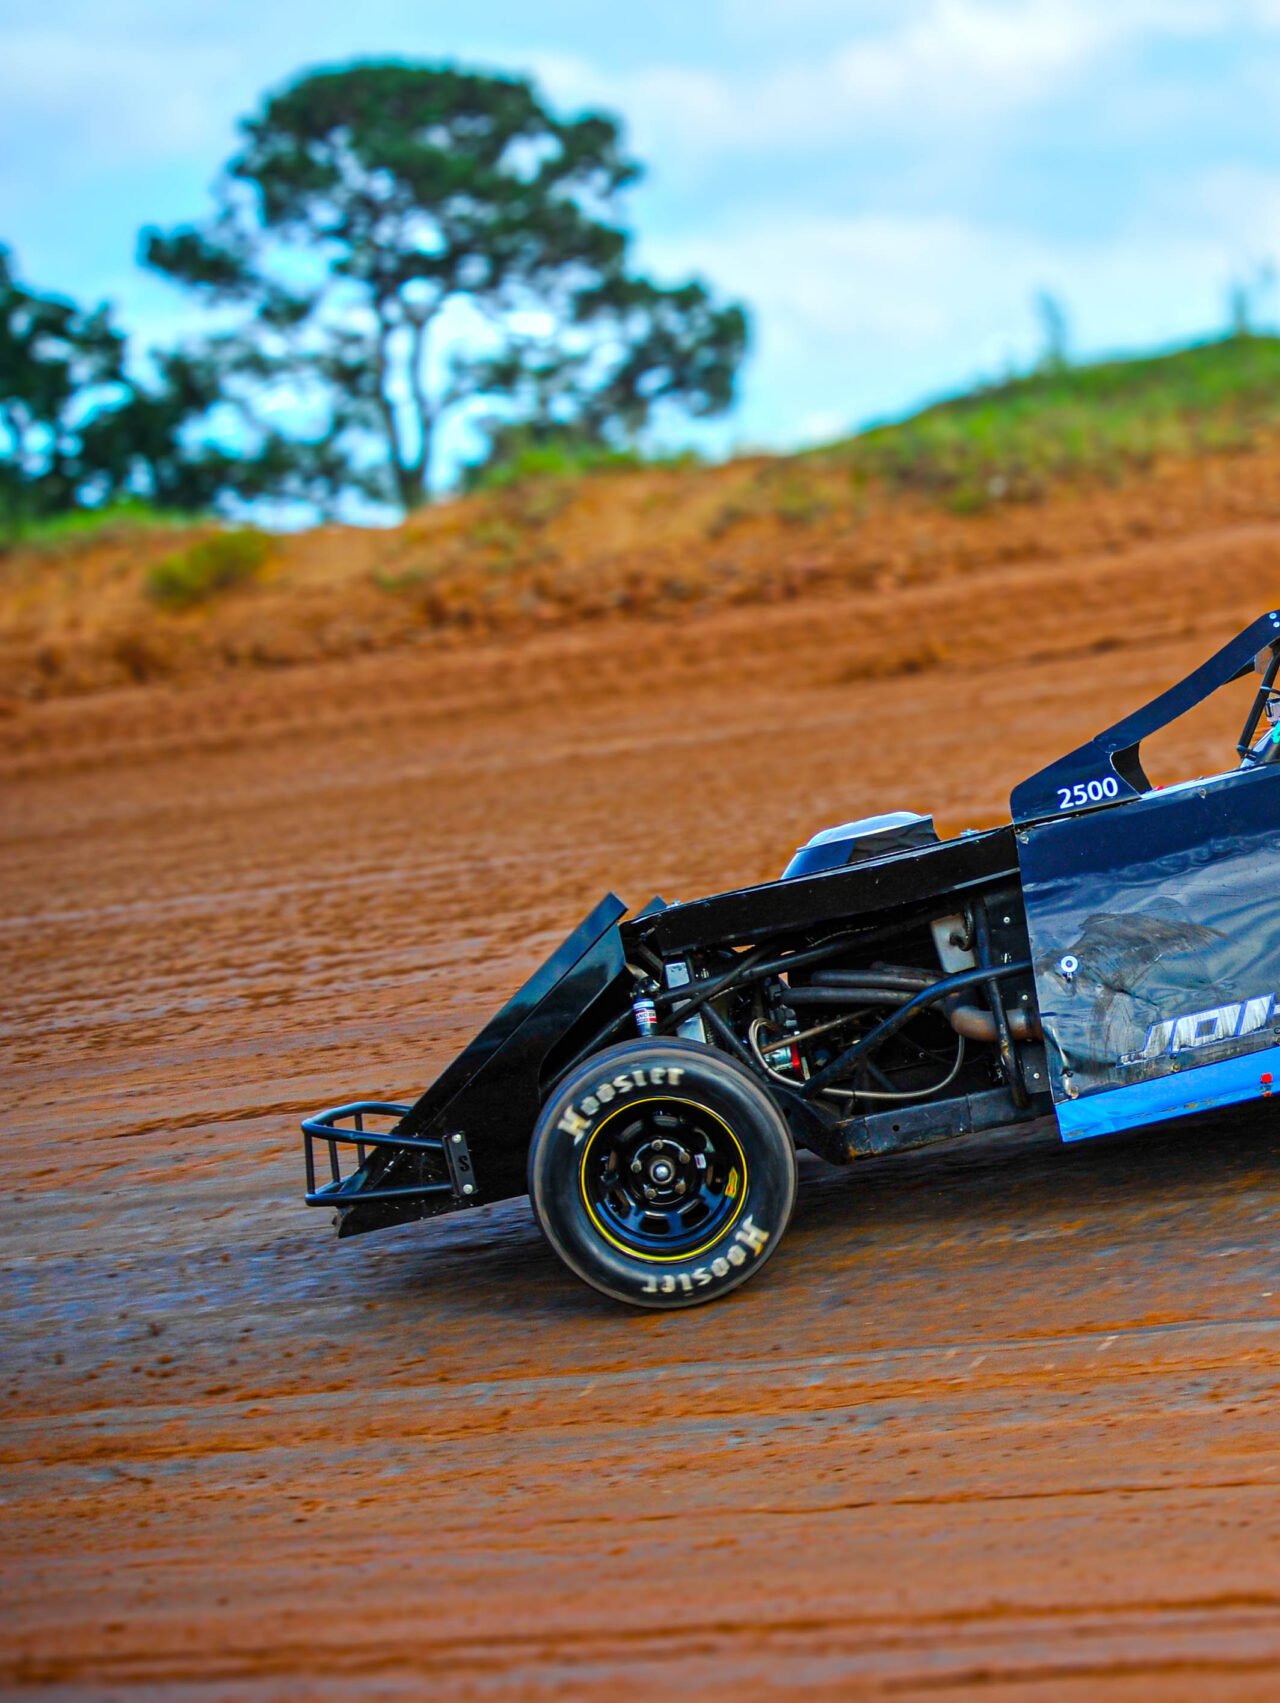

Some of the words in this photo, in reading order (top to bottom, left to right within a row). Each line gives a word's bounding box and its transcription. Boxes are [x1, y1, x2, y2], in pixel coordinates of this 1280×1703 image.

[1056, 776, 1119, 810] 2500
[557, 1065, 685, 1146] Hoosier
[641, 1213, 770, 1294] Hoosier
